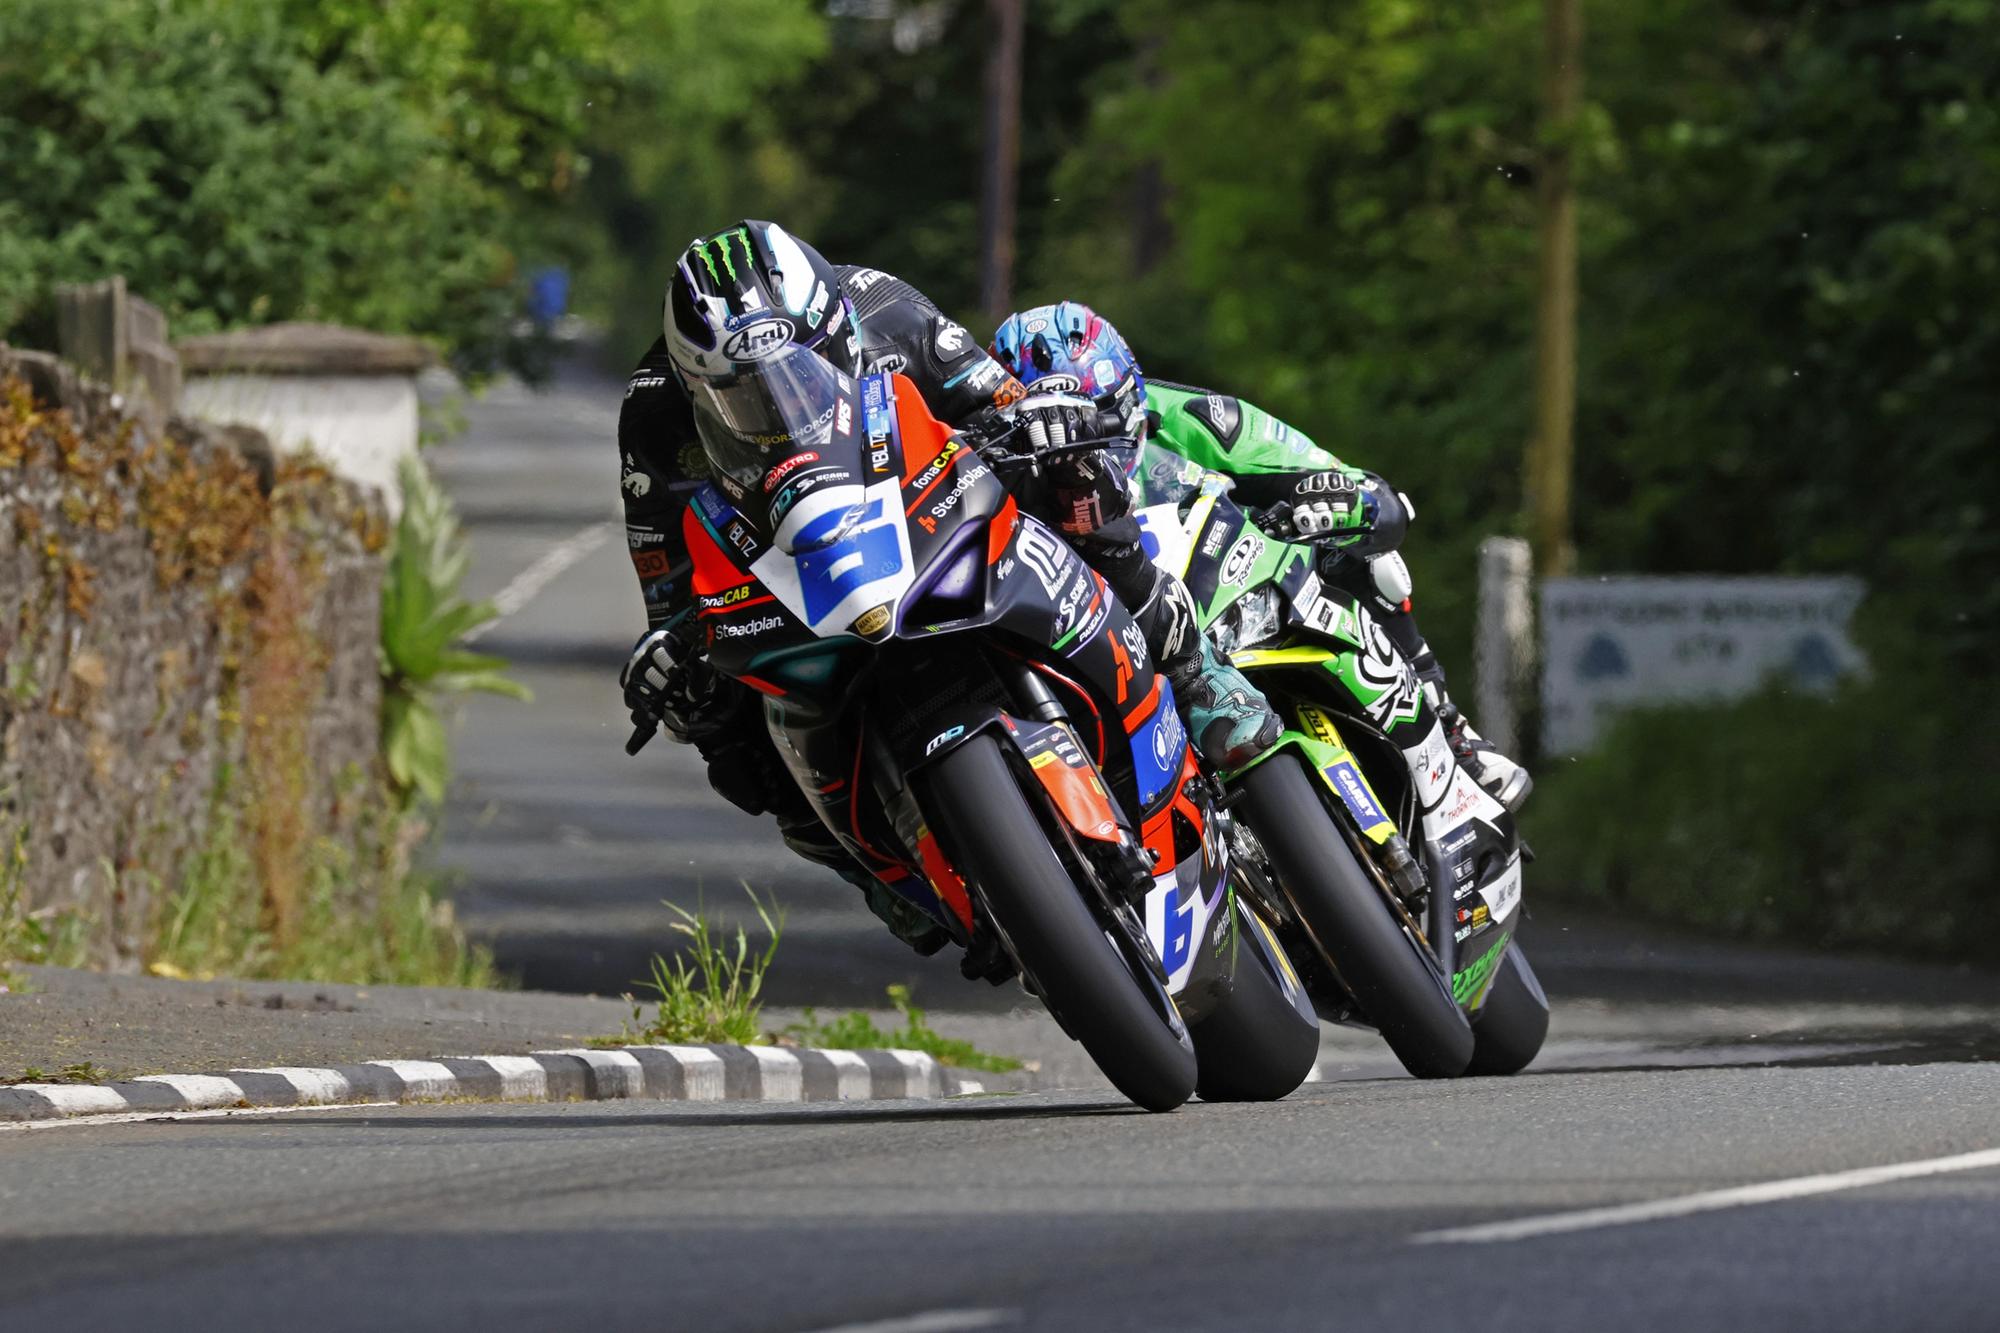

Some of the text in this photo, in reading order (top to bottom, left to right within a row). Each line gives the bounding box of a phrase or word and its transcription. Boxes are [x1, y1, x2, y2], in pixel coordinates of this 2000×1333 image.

[729, 322, 786, 358] Arai
[792, 497, 904, 628] 6
[1163, 886, 1194, 977] 6
